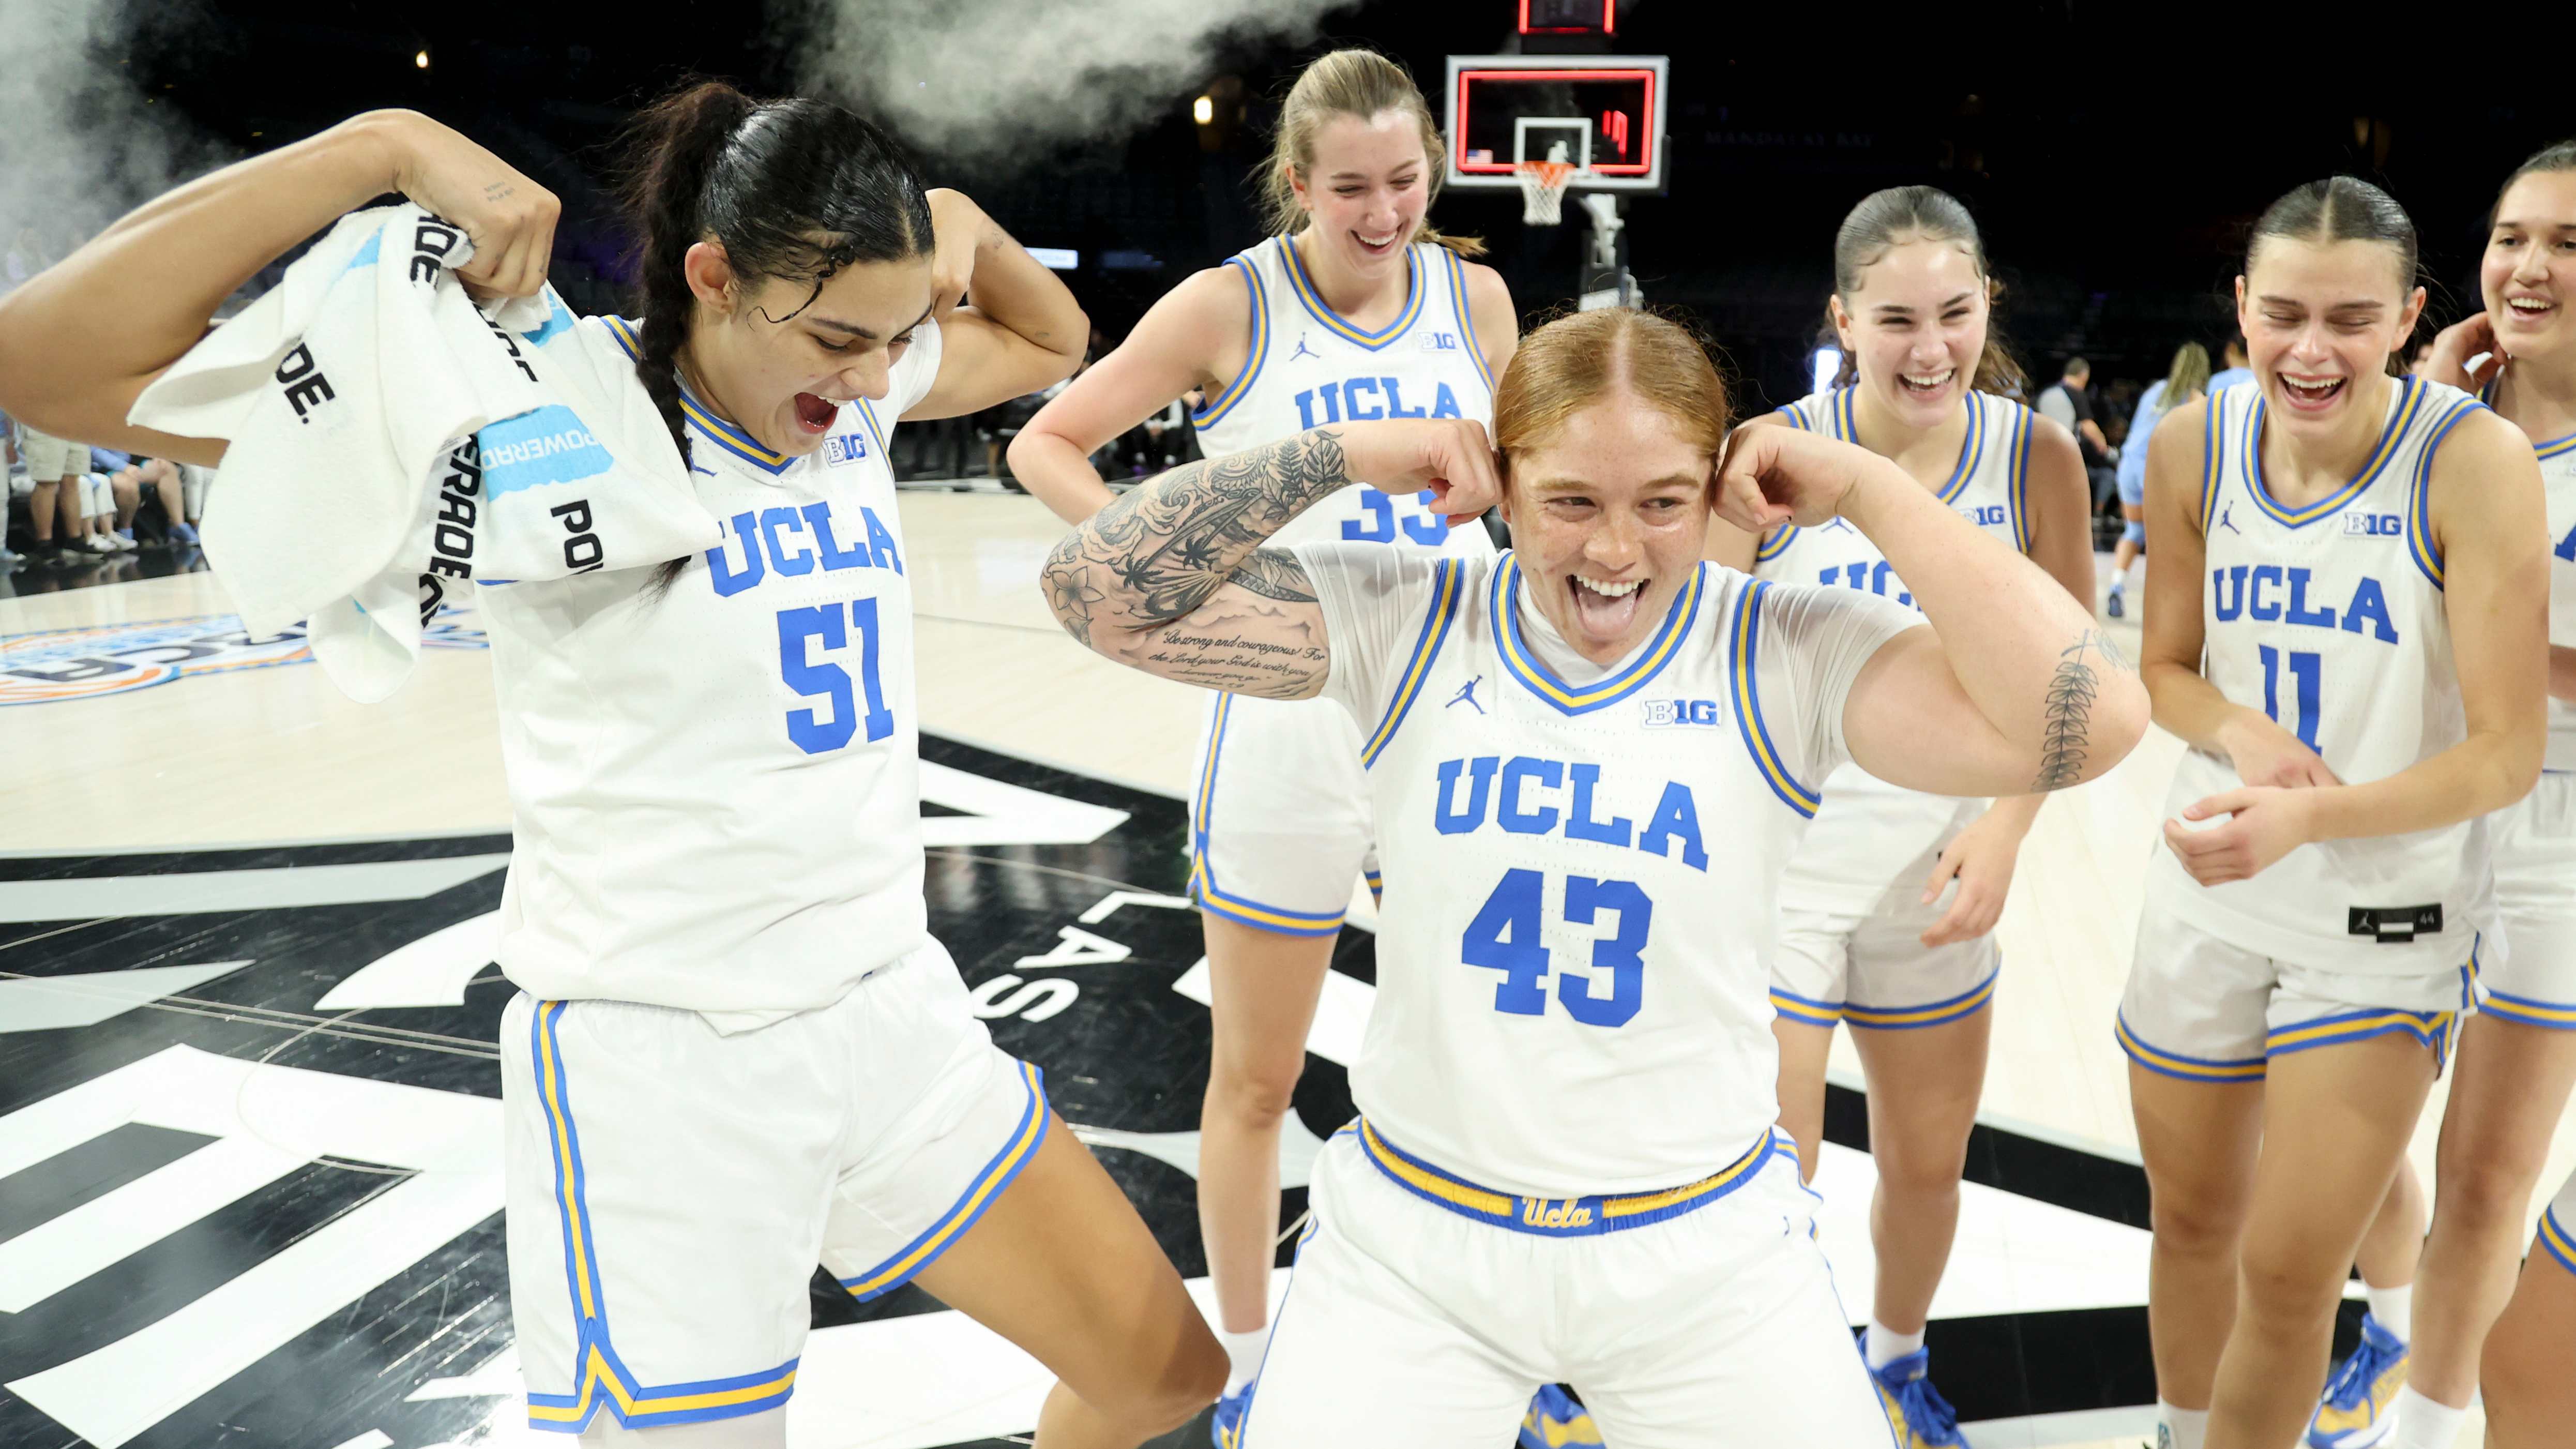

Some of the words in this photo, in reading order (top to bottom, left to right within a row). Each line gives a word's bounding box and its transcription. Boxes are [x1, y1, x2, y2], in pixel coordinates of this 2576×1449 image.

[1295, 377, 1463, 431] UCLA
[551, 499, 603, 575] PO
[706, 501, 903, 597] UCLA
[1180, 635, 1214, 650] strong
[1214, 635, 1241, 647] and
[1237, 641, 1302, 655] courageous!
[1302, 647, 1325, 661] For
[2214, 565, 2398, 645] UCLA
[777, 597, 894, 754] 51
[2259, 643, 2323, 758] 11
[1435, 756, 1709, 873] UCLA
[1461, 868, 1653, 1028] 43
[1521, 1196, 1594, 1229] Ucla
